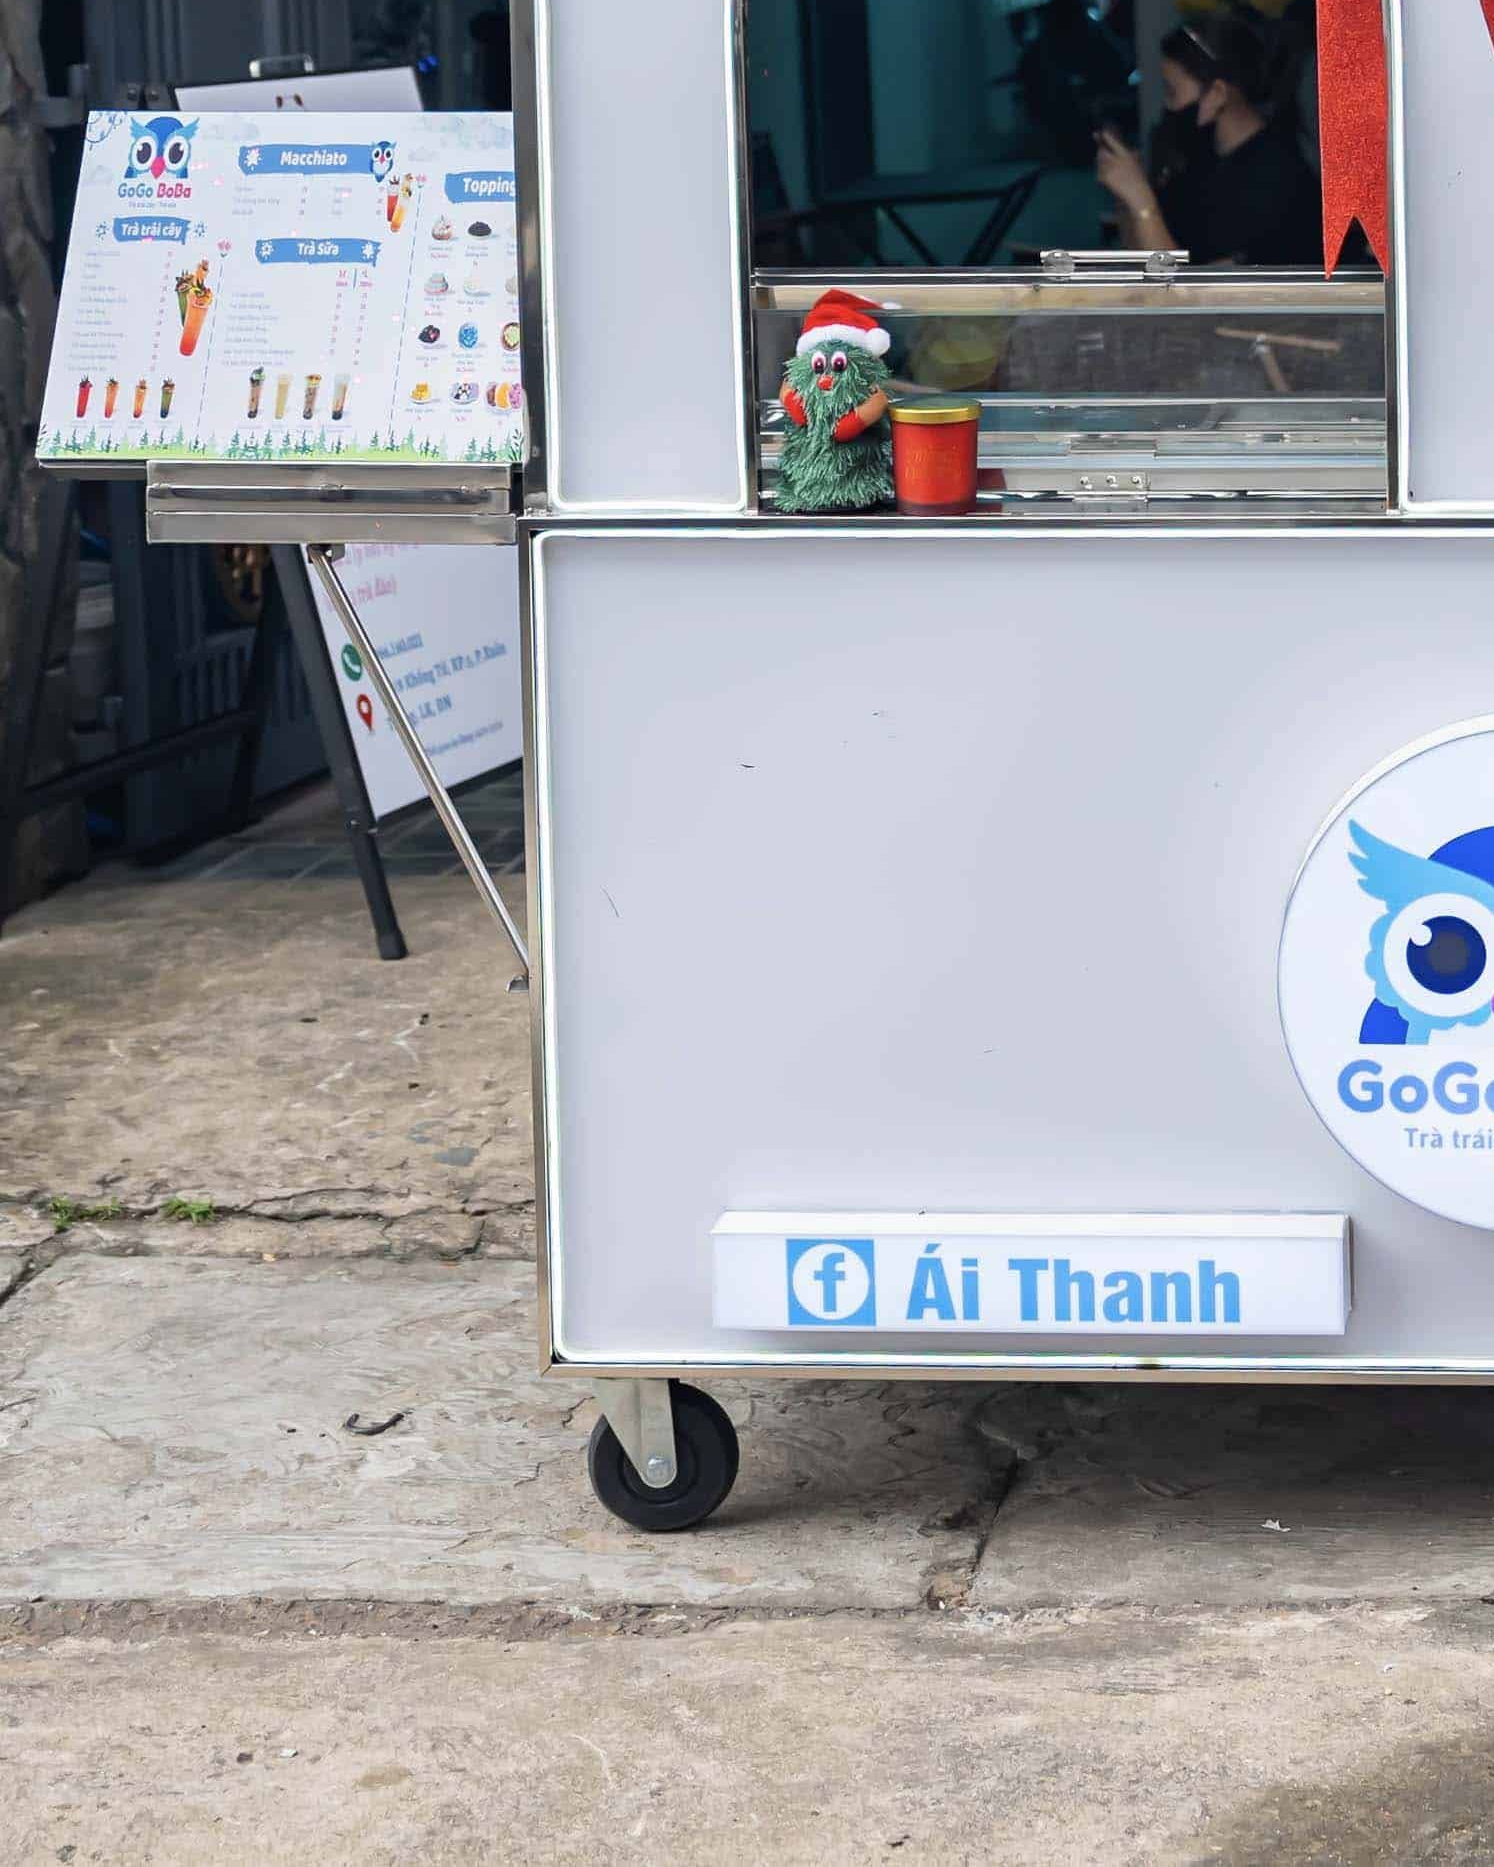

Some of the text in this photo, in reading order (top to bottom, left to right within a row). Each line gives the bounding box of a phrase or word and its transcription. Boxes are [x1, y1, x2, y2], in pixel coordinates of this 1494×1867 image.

[280, 149, 347, 166] Macchiato
[118, 182, 191, 198] GoGo BoBa
[121, 220, 183, 238] Trà trái cây
[297, 240, 340, 255] Trà Sữa
[1403, 1127, 1443, 1149] Trà
[1452, 1128, 1493, 1150] trái
[906, 1243, 980, 1322] Ái
[1008, 1258, 1241, 1324] Thanh
